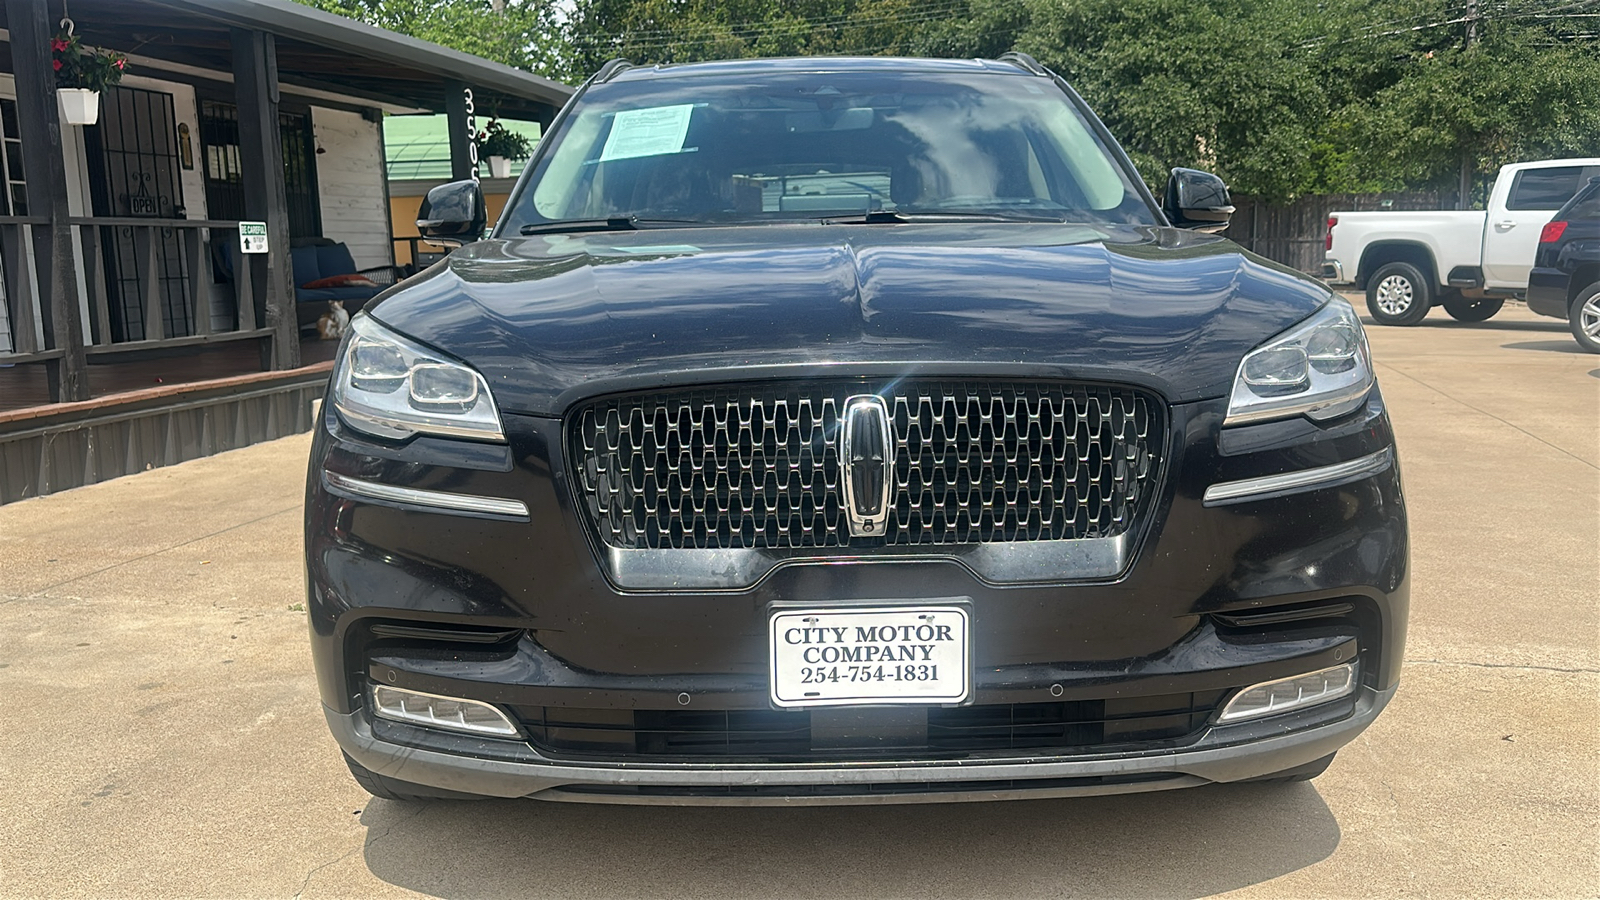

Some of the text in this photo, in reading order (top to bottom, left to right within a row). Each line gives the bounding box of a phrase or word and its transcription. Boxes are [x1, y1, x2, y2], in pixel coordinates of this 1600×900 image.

[133, 198, 156, 213] OPEN
[241, 225, 265, 234] BE CAREFUL
[784, 624, 954, 645] CITY MOTOR
[803, 644, 936, 664] COMPANY
[801, 664, 939, 684] 254-754-1831
